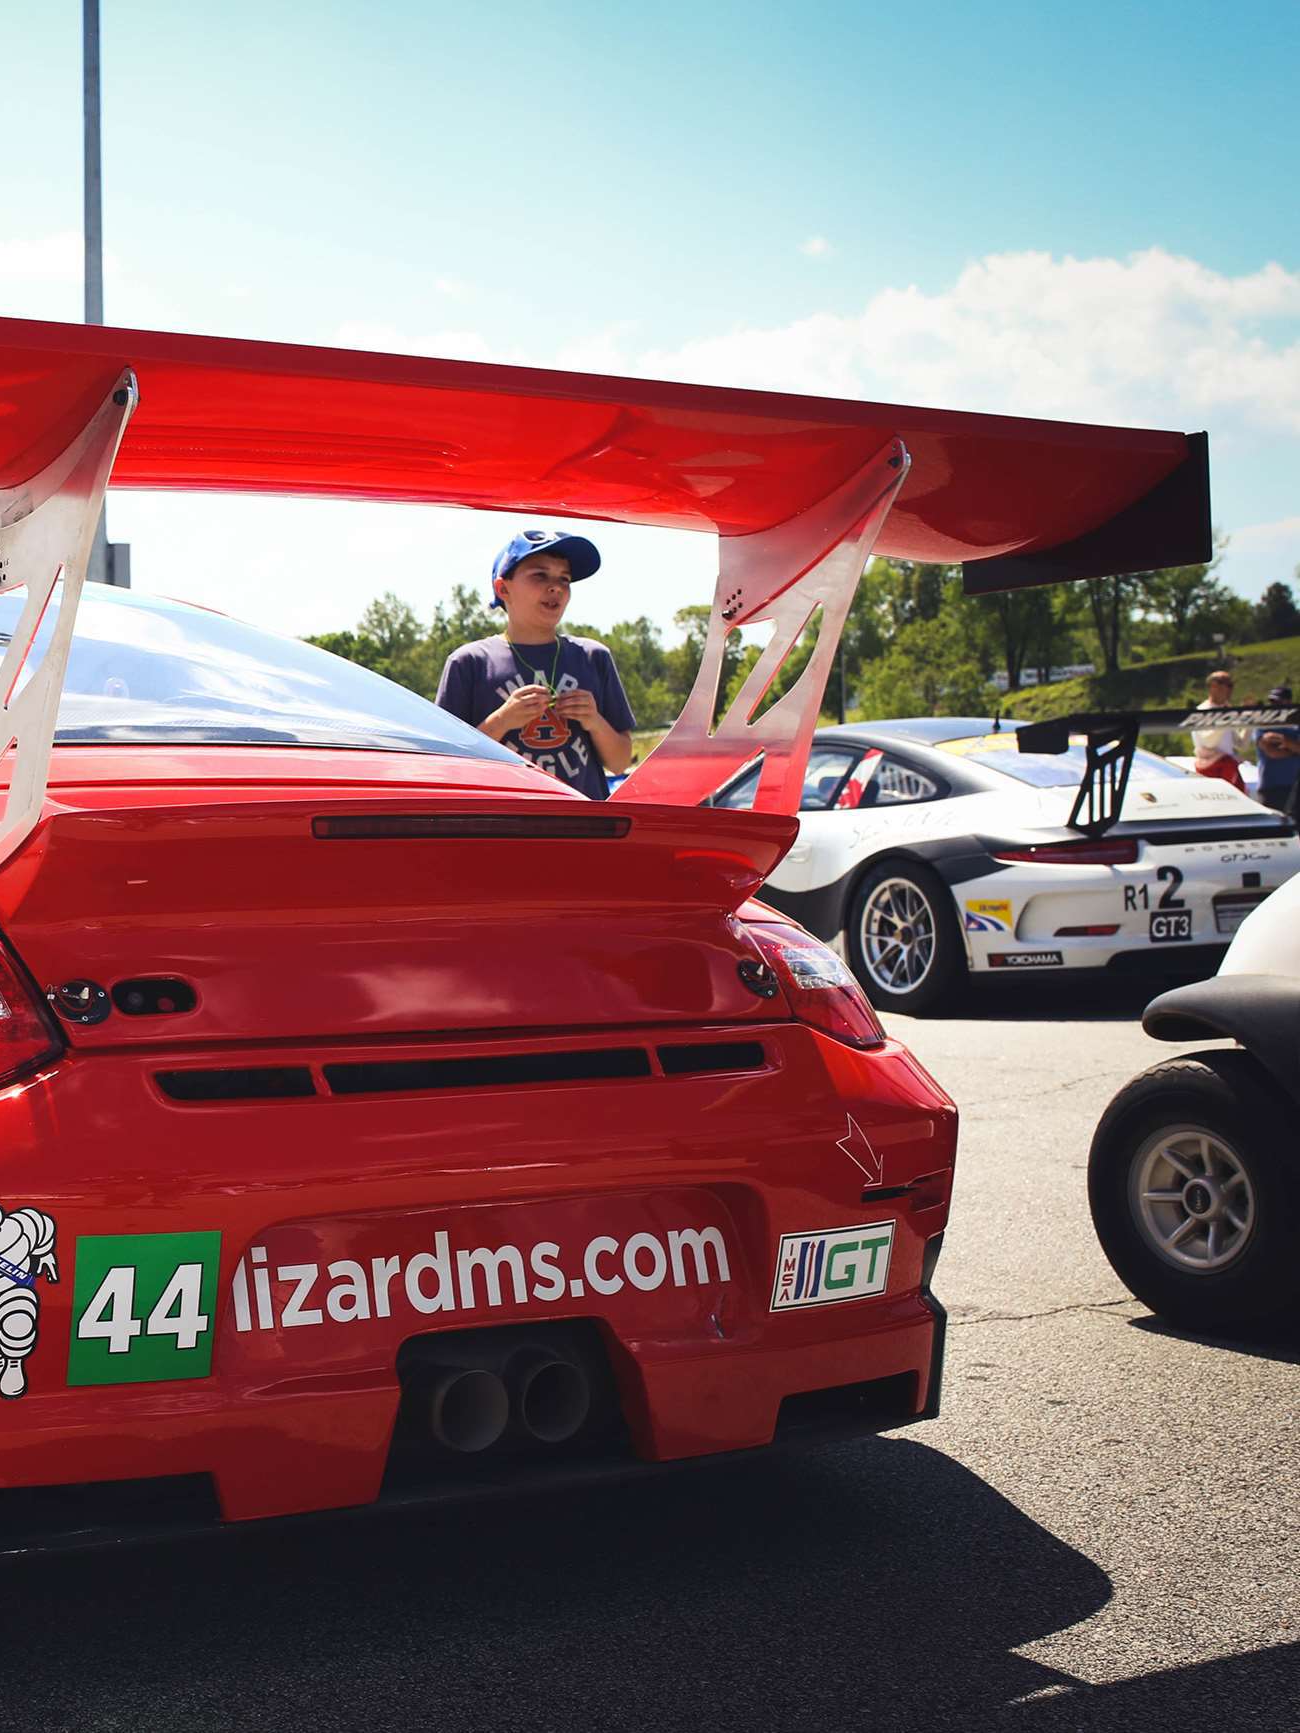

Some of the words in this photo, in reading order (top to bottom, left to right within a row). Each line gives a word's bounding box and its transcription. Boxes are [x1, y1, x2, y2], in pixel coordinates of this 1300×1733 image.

[1178, 708, 1298, 728] PHOENIX
[1124, 884, 1149, 911] R1
[1157, 865, 1185, 909] 2
[1152, 916, 1189, 938] GT3
[1005, 954, 1060, 965] YOKOHAMA
[232, 1226, 731, 1332] lizardms.com
[779, 1243, 796, 1302] IMSA
[824, 1236, 890, 1290] GT
[77, 1263, 209, 1354] 44
